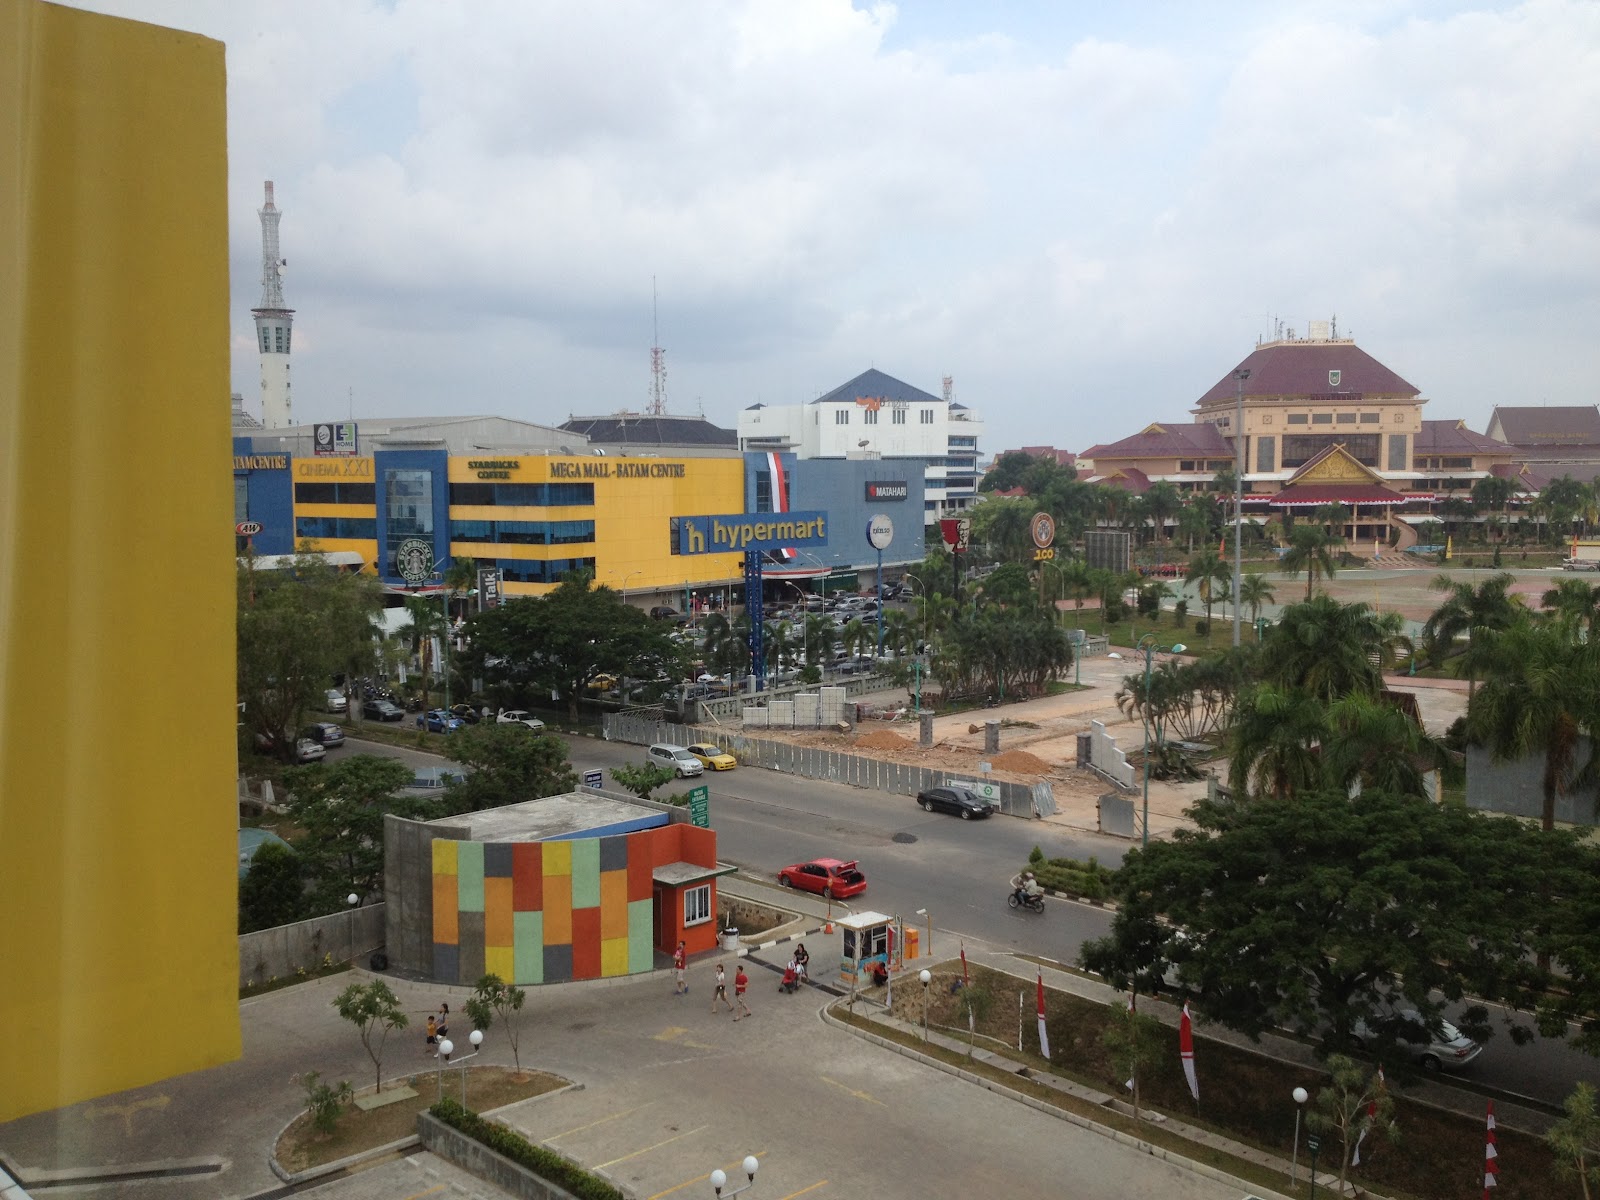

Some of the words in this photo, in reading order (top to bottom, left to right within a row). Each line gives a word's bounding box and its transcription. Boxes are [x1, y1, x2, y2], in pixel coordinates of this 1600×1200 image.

[253, 455, 287, 469] CENTRE
[299, 463, 341, 477] CINEMA
[343, 458, 370, 477] XXI
[468, 460, 519, 469] STARBUCKS
[477, 471, 510, 479] COFFEE
[550, 462, 581, 477] MEGA
[583, 462, 610, 477] MALL
[616, 463, 650, 477] BATAM
[651, 463, 685, 478] CENTRE
[876, 486, 907, 496] MATAHARI
[713, 516, 825, 549] hypermart
[399, 541, 432, 560] STARBUCKS
[403, 570, 428, 580] COFFEE
